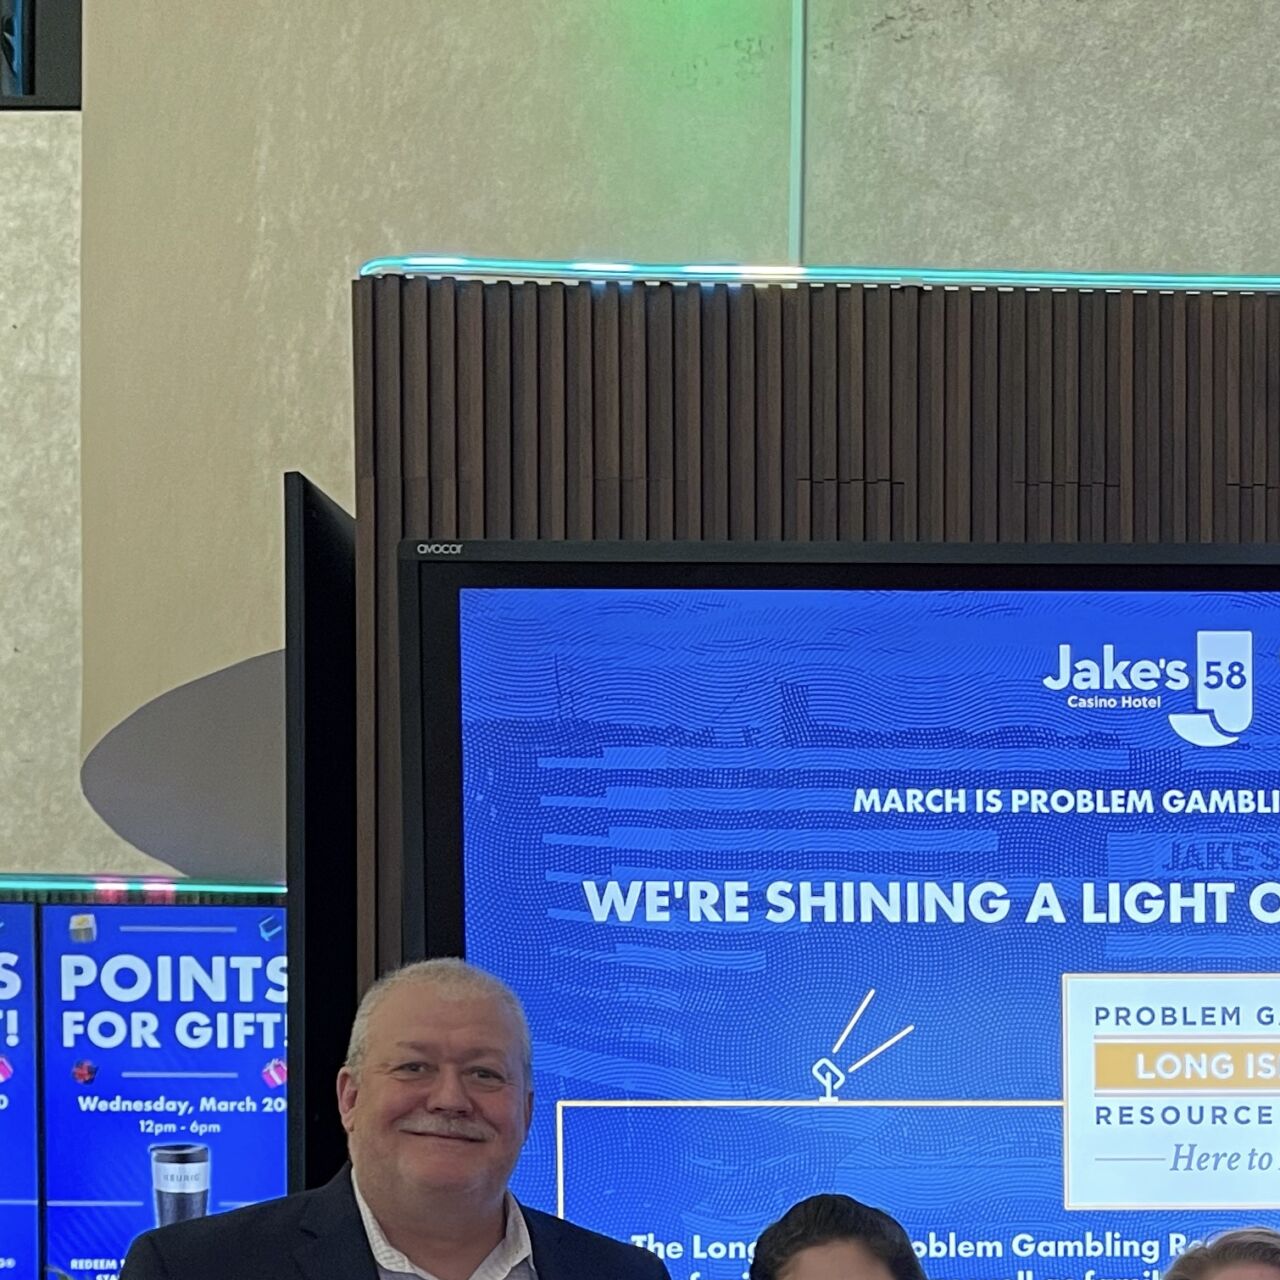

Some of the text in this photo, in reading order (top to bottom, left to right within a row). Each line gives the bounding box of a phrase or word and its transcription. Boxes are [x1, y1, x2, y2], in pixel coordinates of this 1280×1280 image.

[1042, 644, 1247, 691] Jake's 58
[1067, 696, 1161, 709] Casino Hotel
[853, 788, 967, 814] MARCH
[976, 788, 1002, 814] IS
[1011, 788, 1155, 814] PROBLEM
[581, 880, 750, 924] WE'RE
[766, 880, 1010, 924] SHINING
[1025, 881, 1067, 924] A
[1082, 881, 1236, 924] LIGHT
[60, 953, 288, 1004] POINTS
[1095, 1006, 1241, 1026] PROBLEM
[62, 1011, 160, 1049] FOR
[175, 1011, 288, 1049] GIFT
[1137, 1052, 1234, 1080] LONG
[77, 1095, 287, 1116] Wednesday, March 20
[1095, 1105, 1274, 1125] RESOURCE
[139, 1120, 221, 1136] 12pm 6pm
[1169, 1143, 1242, 1172] Here
[1248, 1147, 1273, 1172] to
[911, 1231, 1003, 1258] oblem
[1011, 1231, 1160, 1264] Gambling
[70, 1259, 118, 1270] REDEEM
